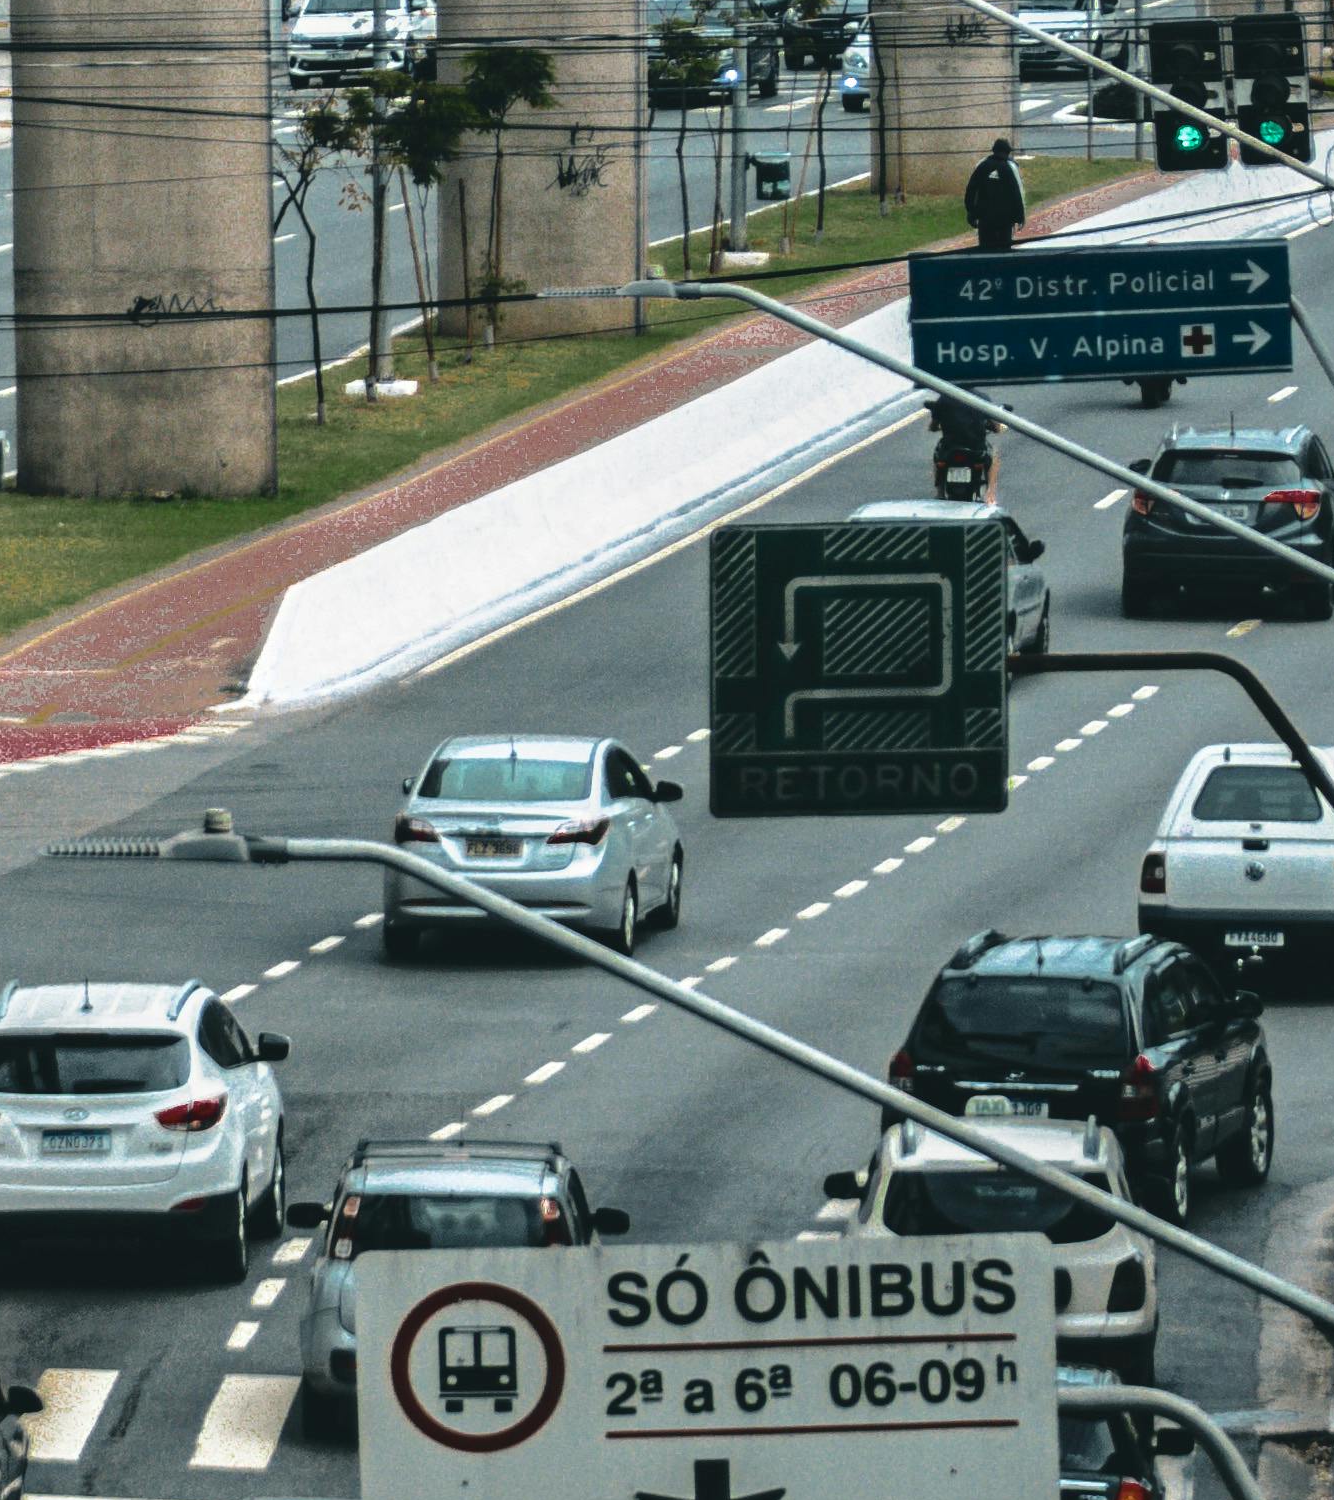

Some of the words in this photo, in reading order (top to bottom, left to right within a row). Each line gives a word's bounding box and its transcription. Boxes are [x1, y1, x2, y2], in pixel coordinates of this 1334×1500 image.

[1015, 272, 1098, 299] Distr.
[1109, 269, 1215, 295] Policial
[936, 339, 1013, 367] Hosp.
[1030, 336, 1059, 360] V.
[1073, 331, 1165, 361] Alpina
[740, 763, 979, 800] RETORNO
[604, 1254, 709, 1328] SÓ
[733, 1252, 1018, 1322] ÔNIBUS
[605, 1369, 665, 1416] 2ª
[683, 1378, 715, 1414] a
[734, 1364, 793, 1415] 6ª
